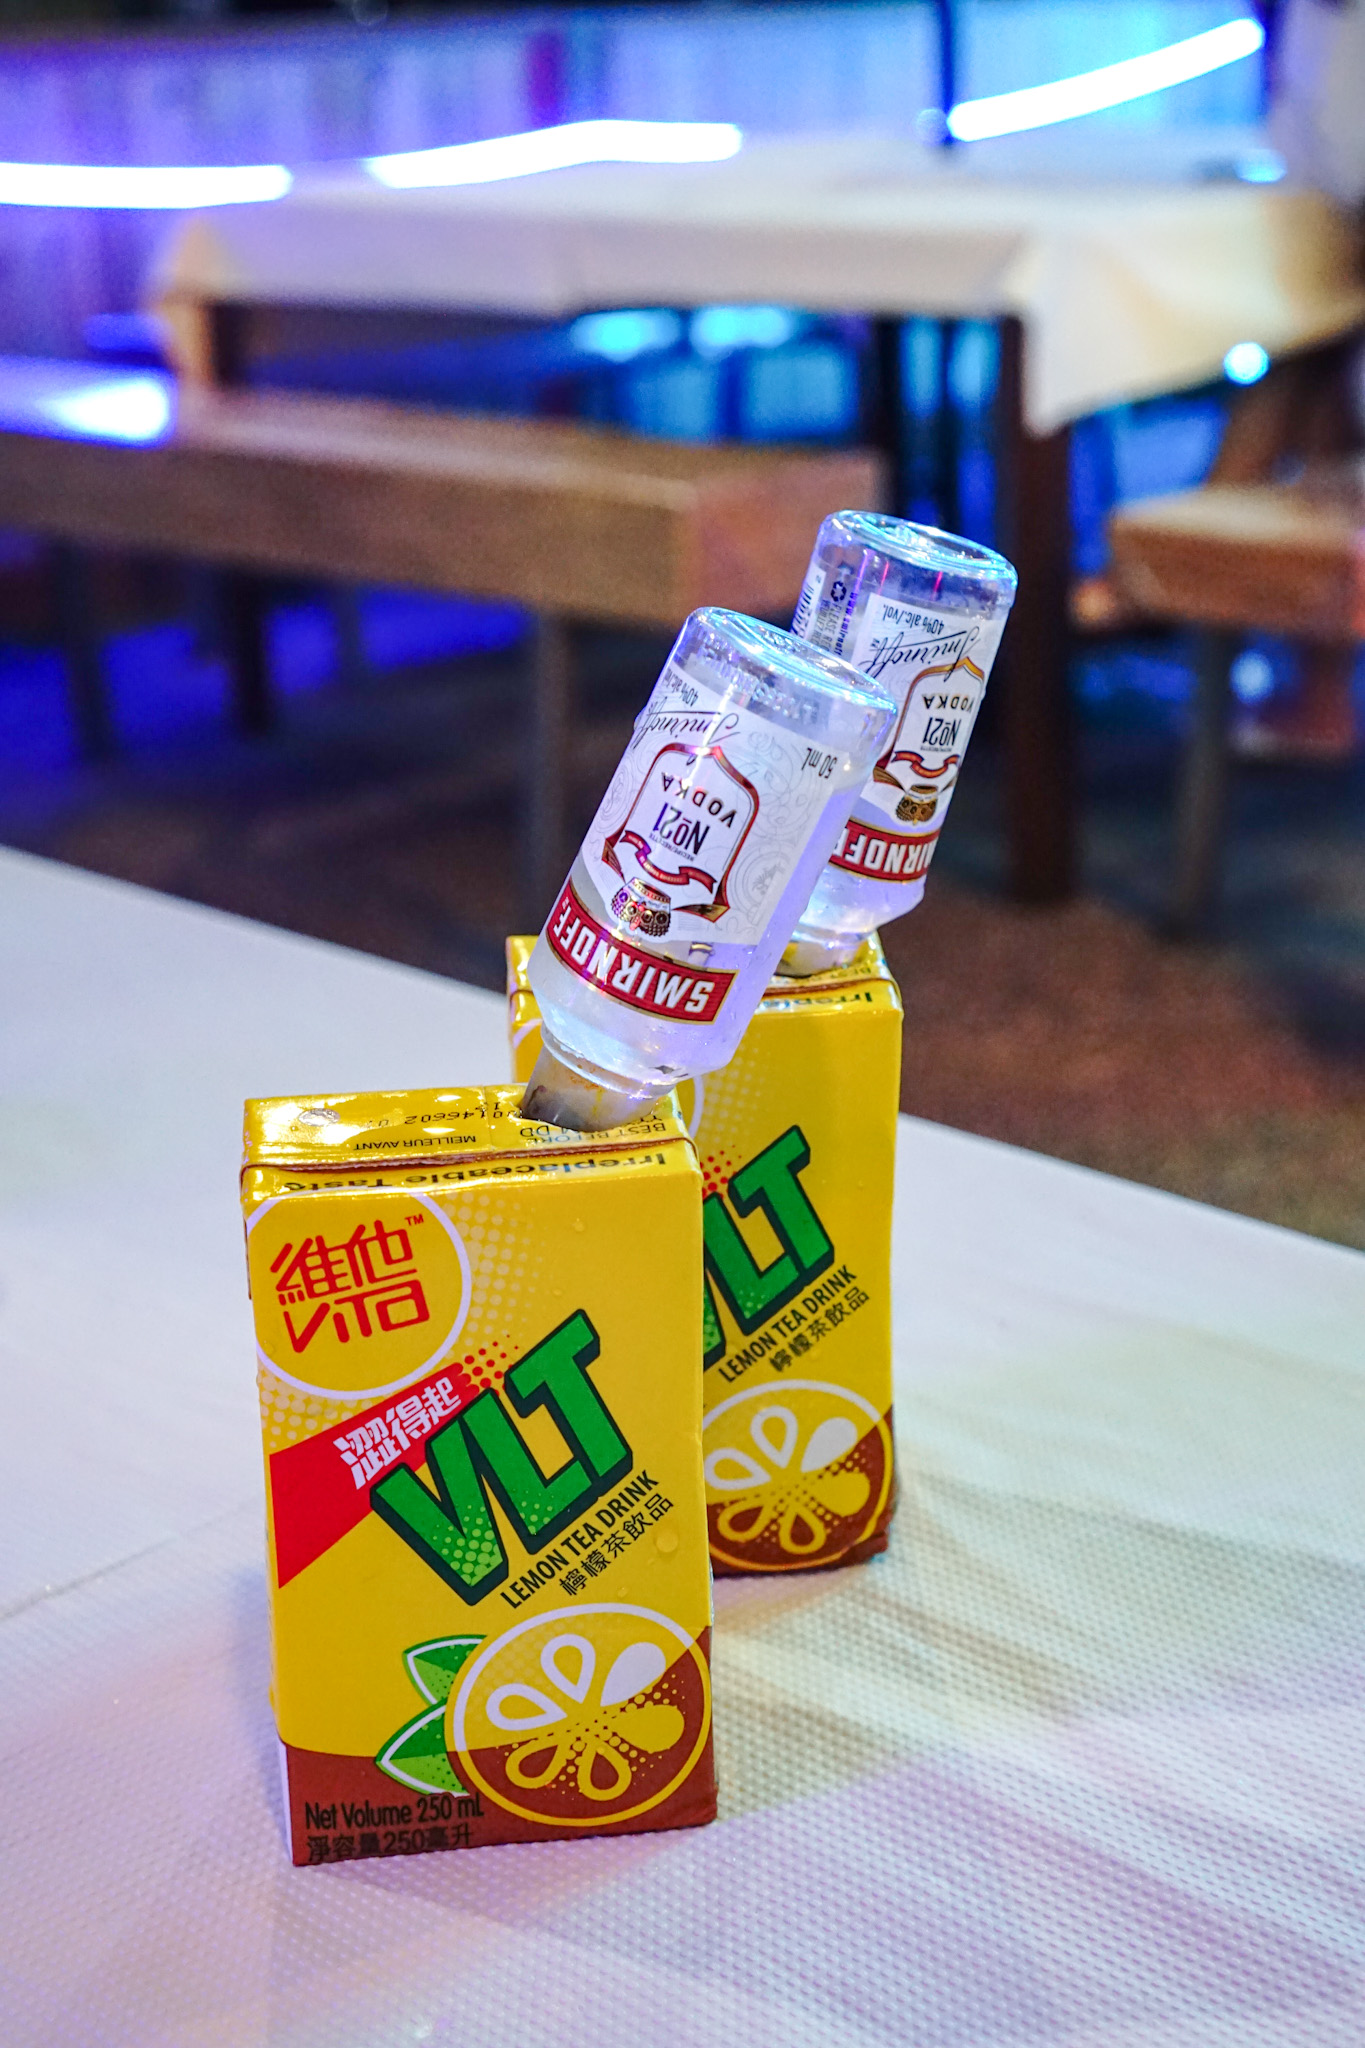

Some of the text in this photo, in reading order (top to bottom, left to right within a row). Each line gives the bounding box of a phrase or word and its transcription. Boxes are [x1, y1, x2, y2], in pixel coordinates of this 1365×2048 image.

[858, 626, 981, 682] Smirnoff
[923, 617, 944, 635] 40%
[633, 696, 741, 766] Smirnoff
[921, 694, 975, 713] VODKA
[801, 747, 838, 779] 50 mL
[661, 772, 737, 828] VODKA
[553, 906, 715, 1014] SMIRNOFF
[353, 1135, 476, 1150] MEILLEUR AVANT
[627, 1122, 667, 1133] BEST
[284, 1152, 666, 1191] Irreplaceable Taste
[270, 1219, 418, 1306] 維他
[703, 1125, 835, 1373] LT
[718, 1264, 858, 1383] LEMON TEA DRINK
[370, 1308, 633, 1606] VLT
[500, 1469, 660, 1609] LEMON TEA DRINK
[559, 1493, 675, 1596] 檸檬茶飲品
[305, 1791, 485, 1830] Net Volume 250 mL
